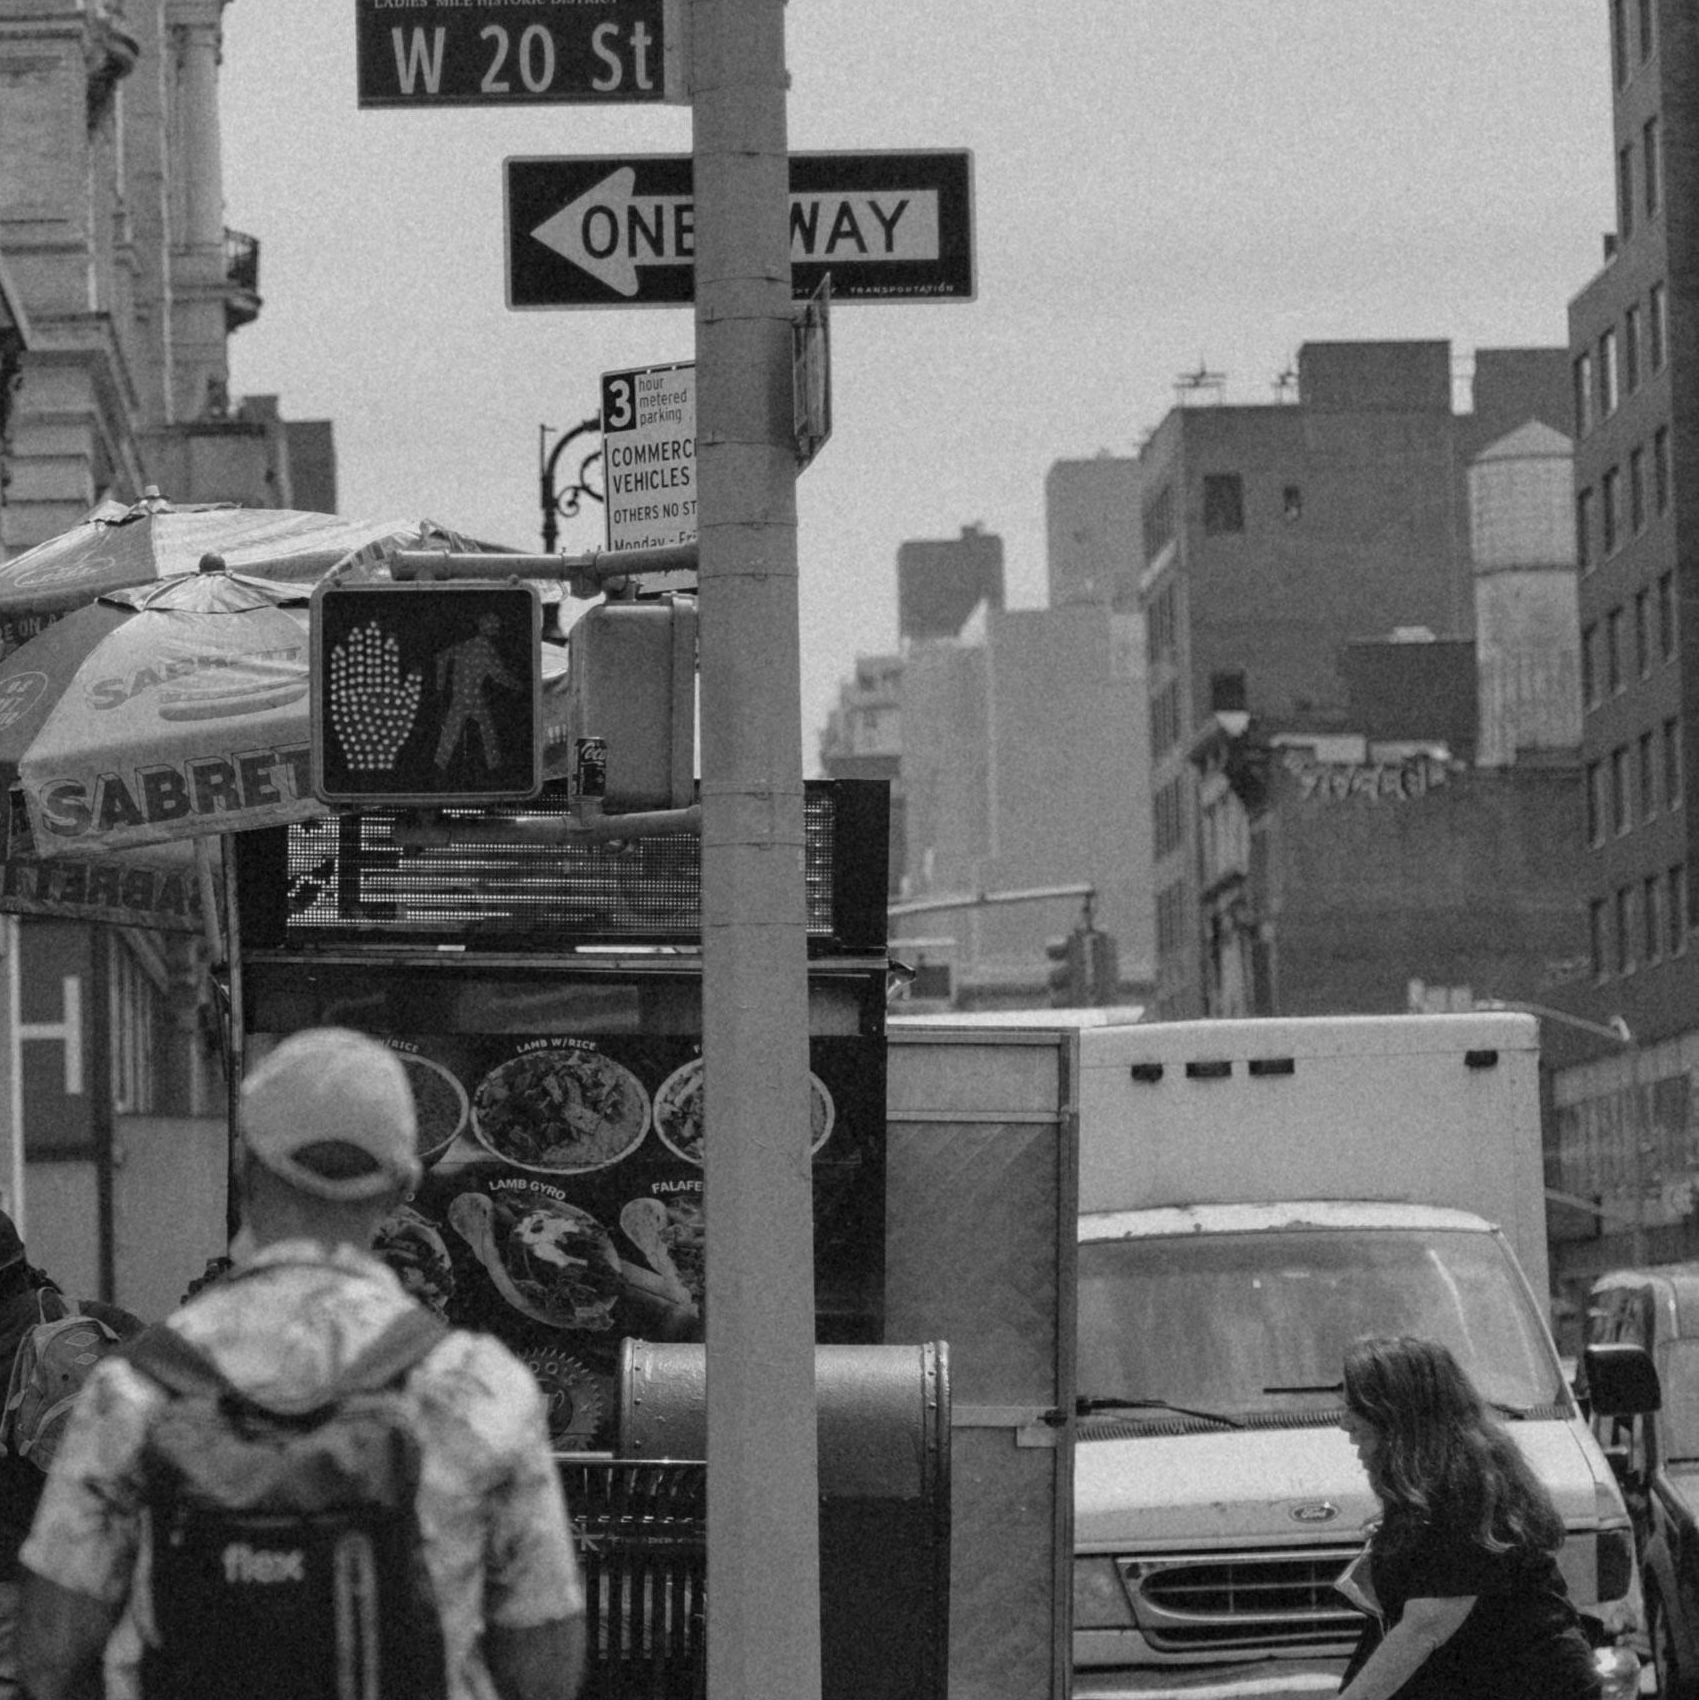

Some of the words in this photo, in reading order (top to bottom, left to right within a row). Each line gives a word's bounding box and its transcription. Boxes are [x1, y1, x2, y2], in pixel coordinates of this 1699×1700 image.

[391, 26, 446, 94] W
[480, 23, 555, 93] 20
[591, 20, 653, 91] St
[581, 204, 694, 259] ONE
[638, 377, 664, 392] hour
[608, 379, 632, 428] 3
[639, 388, 687, 408] metered
[639, 407, 682, 427] parking
[611, 437, 697, 467] COMMERCI
[613, 466, 690, 495] VEHICLES
[613, 505, 659, 524] OTHERS
[662, 502, 679, 518] NO
[682, 500, 697, 516] ST
[40, 742, 310, 837] SABRET
[380, 1035, 420, 1053] /RICE
[516, 1038, 549, 1053] LAMB
[550, 1037, 597, 1051] W/RICE
[489, 1178, 526, 1191] LAMB
[530, 1180, 566, 1201] GYRO
[651, 1180, 703, 1194] FALAFE
